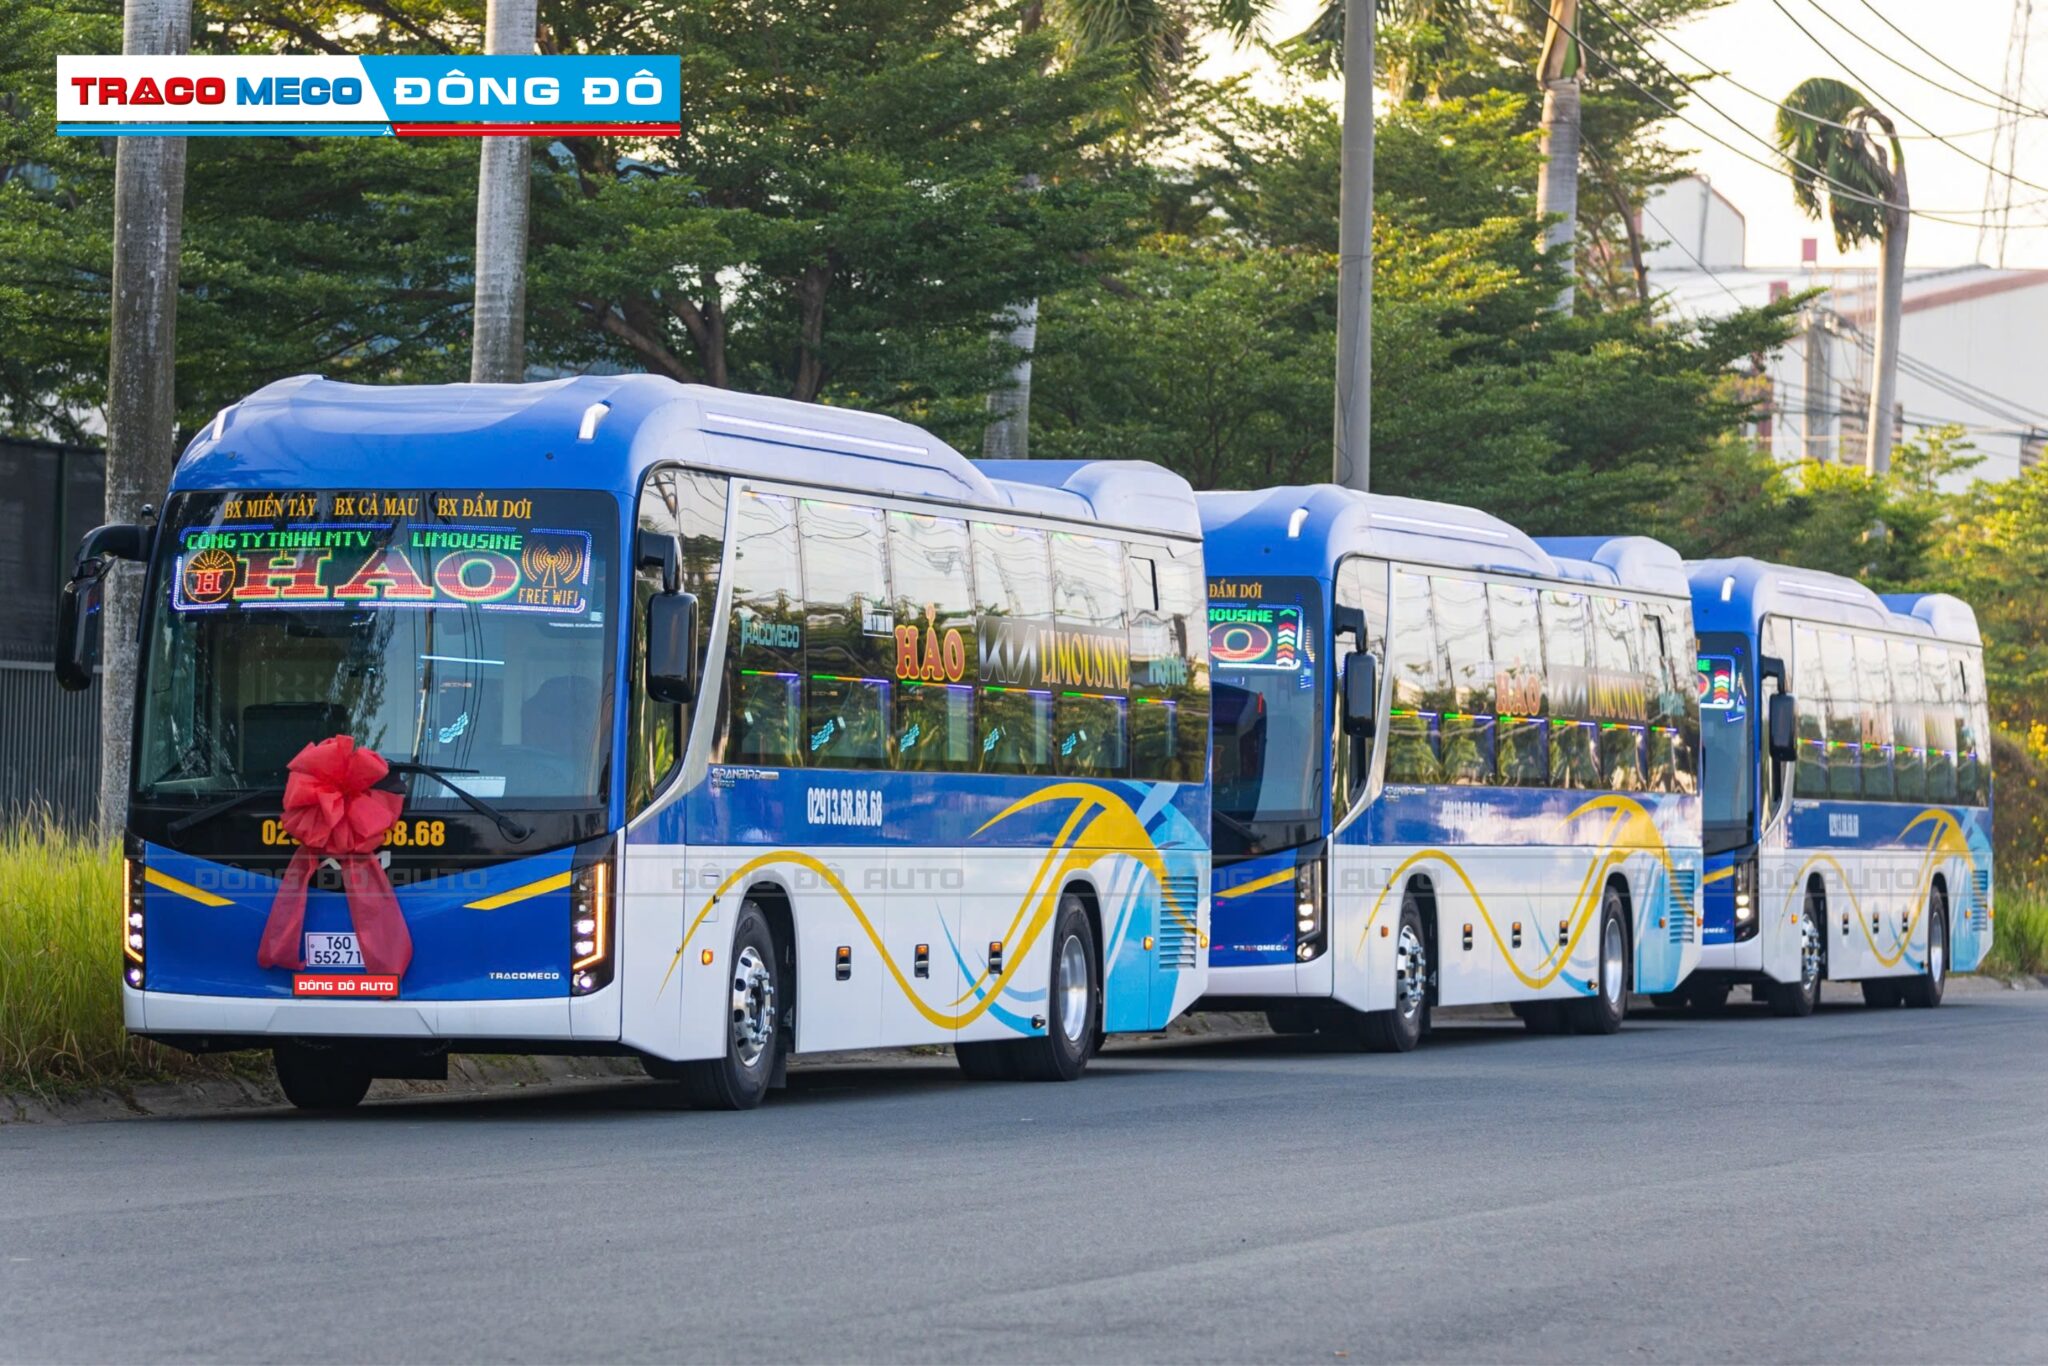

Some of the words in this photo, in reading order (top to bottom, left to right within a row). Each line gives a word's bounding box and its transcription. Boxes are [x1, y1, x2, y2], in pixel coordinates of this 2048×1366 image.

[224, 501, 242, 519] BX
[245, 492, 284, 518] MIỀN
[287, 494, 318, 517] TÂY
[334, 497, 353, 516] BX
[383, 497, 418, 516] MAU
[437, 498, 458, 517] BX
[502, 498, 533, 519] DƠI
[187, 531, 236, 549] CÔNG
[240, 532, 264, 548] TY
[267, 532, 321, 548] TNHH
[325, 531, 371, 547] MTV
[412, 532, 523, 551] LIMOUSINE
[518, 588, 549, 605] FREE
[553, 590, 580, 607] WIFI
[895, 602, 965, 682] HẢO
[1039, 628, 1130, 692] LIMOUSINE
[807, 787, 883, 827] 02913.68.68.68
[326, 936, 351, 950] T60
[314, 950, 361, 965] 552.71
[298, 979, 333, 991] ĐÔNG
[338, 979, 356, 991] ĐÔ
[360, 981, 394, 991] AUTO
[489, 972, 560, 980] TRACOMECO
